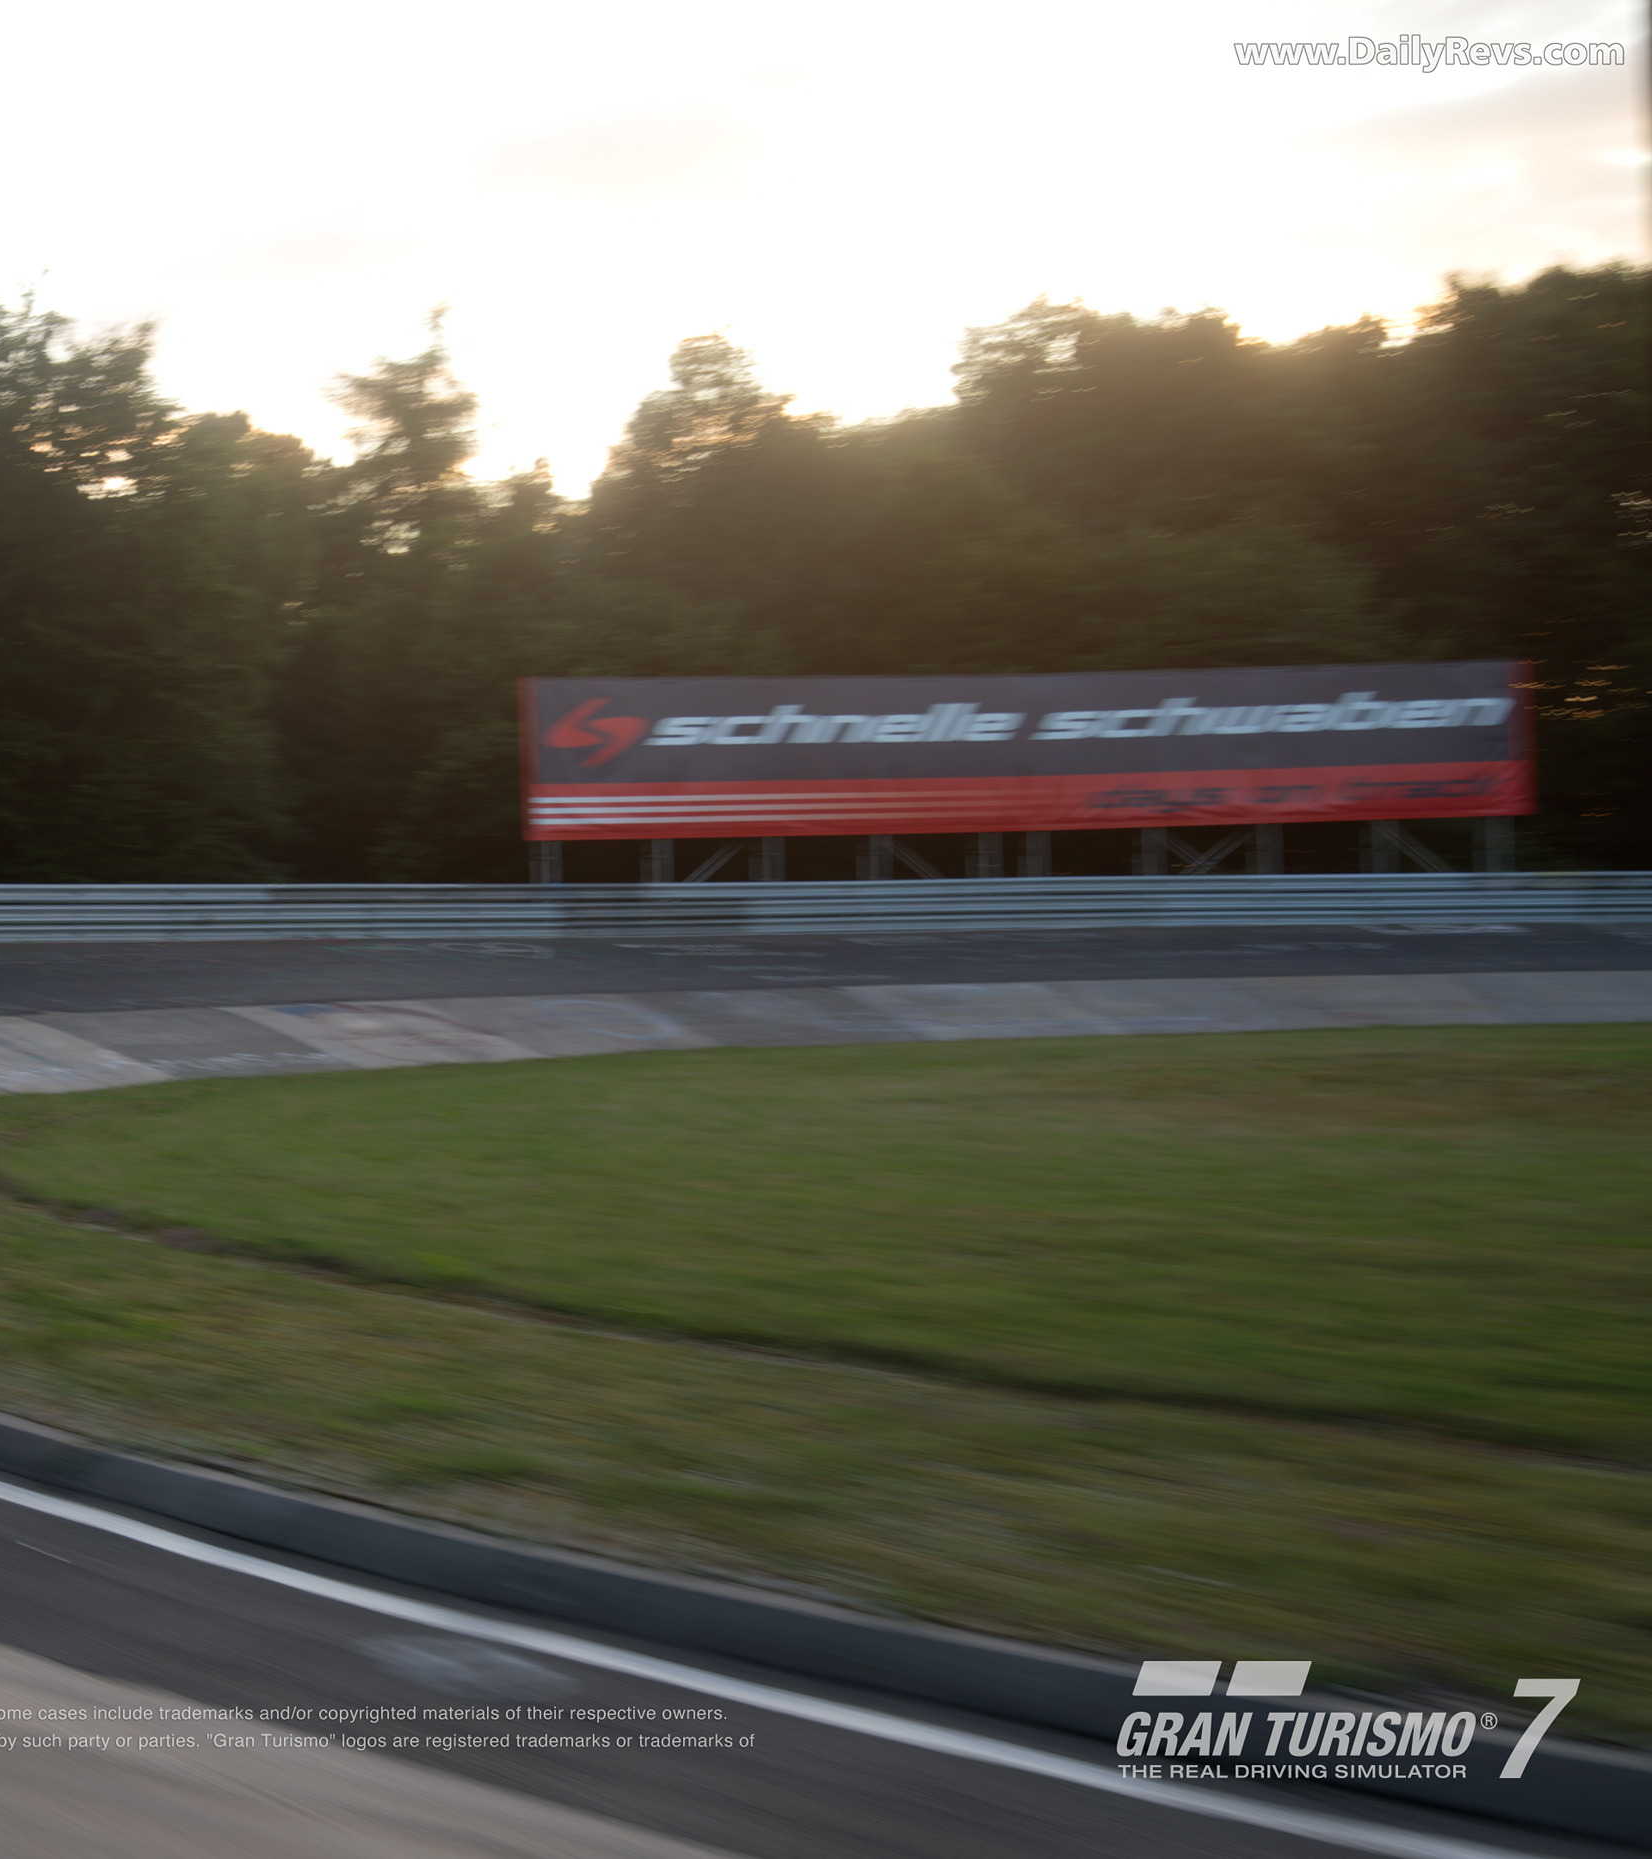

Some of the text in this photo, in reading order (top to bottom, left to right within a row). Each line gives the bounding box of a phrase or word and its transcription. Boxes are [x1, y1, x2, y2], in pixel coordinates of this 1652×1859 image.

[643, 692, 1515, 746] schnelle schwaben
[1245, 784, 1330, 805] on
